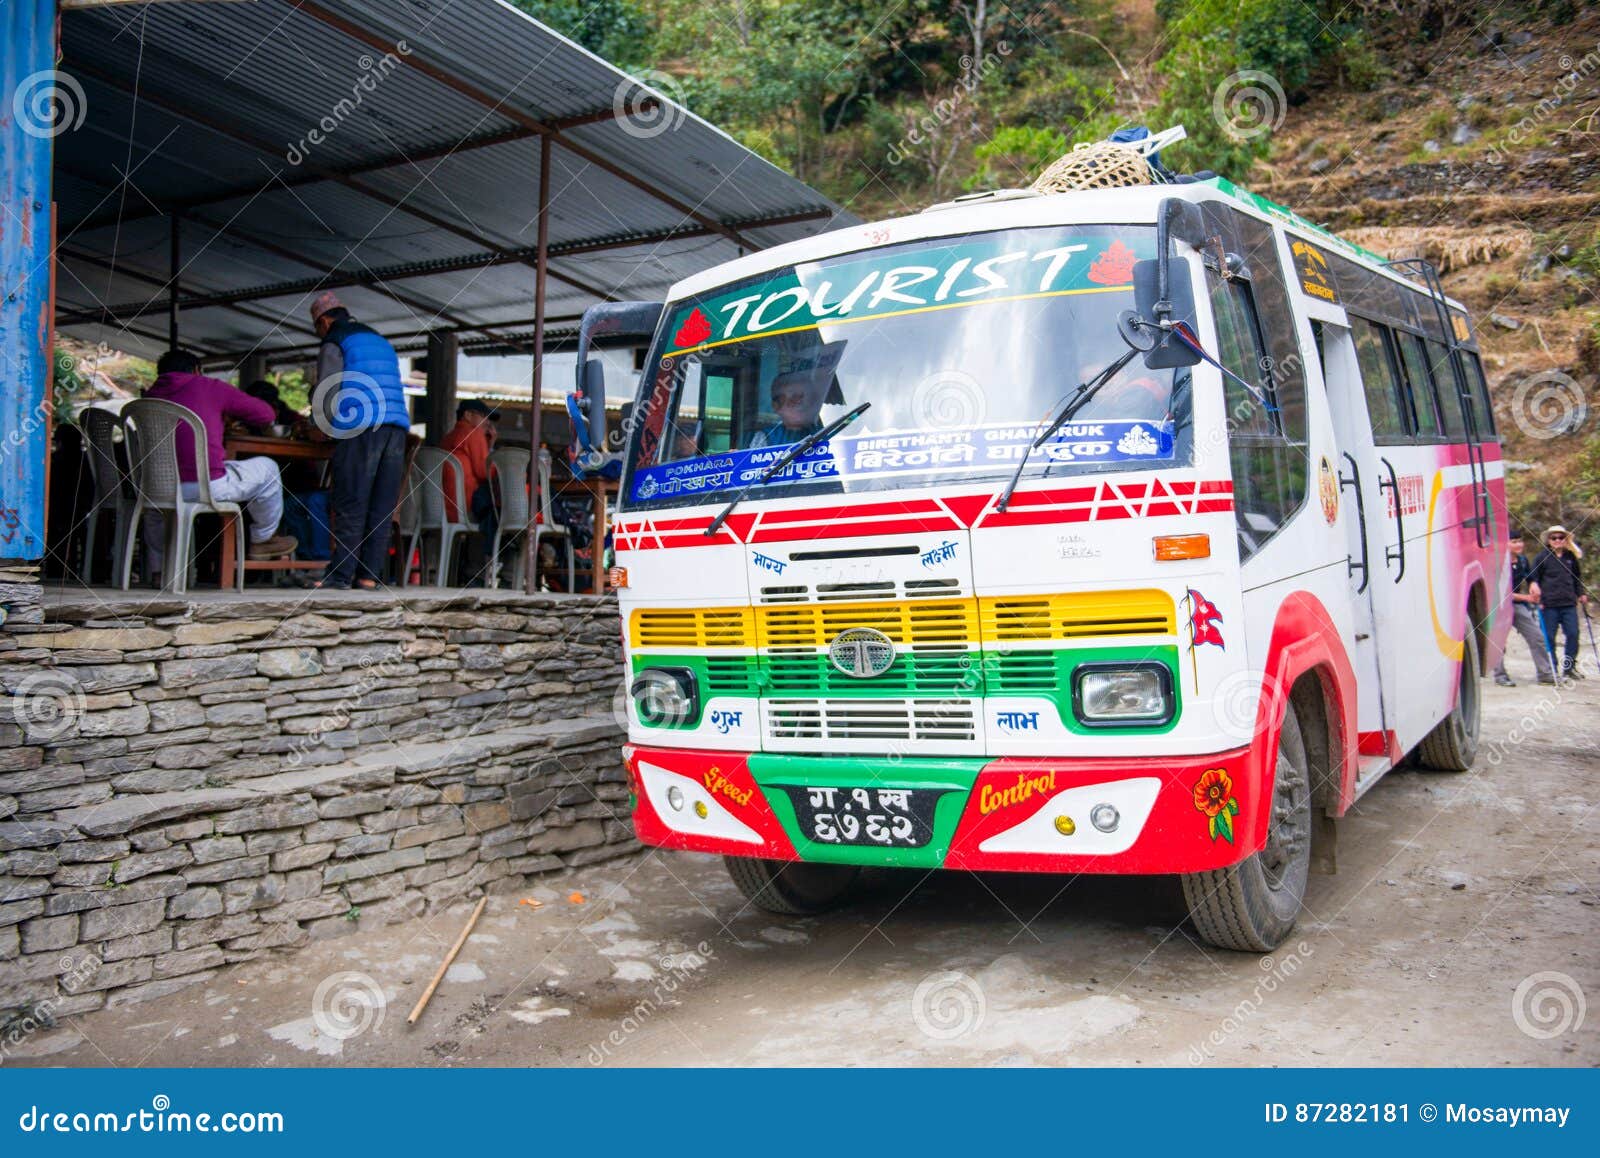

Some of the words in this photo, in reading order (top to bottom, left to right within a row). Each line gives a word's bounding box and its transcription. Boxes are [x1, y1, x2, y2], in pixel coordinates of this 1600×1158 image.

[719, 243, 1088, 340] TOURIST
[665, 457, 734, 478] POKHARA
[856, 431, 973, 450] BIRETHANTI
[751, 551, 788, 576] भाग्य
[711, 710, 743, 734] शुभ
[997, 712, 1040, 736] लाभ
[703, 766, 754, 807] Speed
[980, 768, 1057, 815] Control
